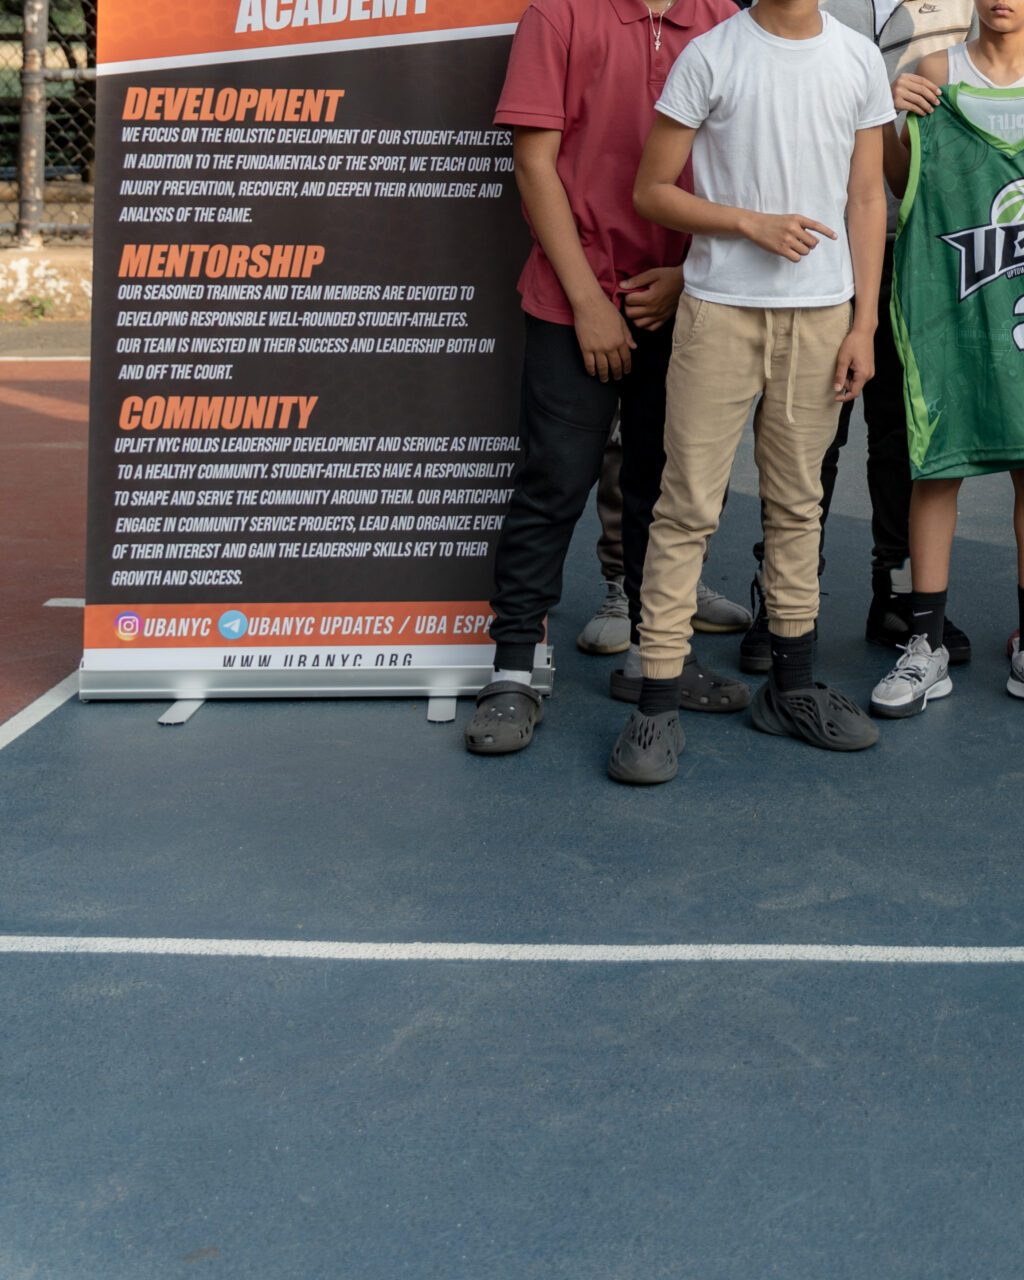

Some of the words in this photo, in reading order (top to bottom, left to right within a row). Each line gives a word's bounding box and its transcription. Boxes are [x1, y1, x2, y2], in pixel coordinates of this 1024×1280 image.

[121, 87, 345, 122] DEVELOPMENT
[121, 126, 142, 142] WE
[141, 126, 181, 143] FOCUS
[180, 127, 200, 143] ON
[201, 127, 224, 143] THE
[223, 127, 277, 144] HOLISTIC
[276, 128, 361, 144] DEVELOPMENT
[360, 129, 378, 145] OF
[377, 129, 402, 145] OUR
[402, 129, 512, 146] STUDENT-ATHLETES.
[119, 180, 162, 196] INJURY
[161, 180, 236, 198] PREVENTION,
[238, 180, 300, 199] RECOVERY,
[300, 181, 326, 197] AND
[326, 181, 372, 197] DEEPEN
[374, 182, 407, 197] THEIR
[407, 182, 478, 198] KNOWLEDGE
[478, 183, 503, 198] AND
[118, 206, 175, 223] ANALYSIS
[175, 206, 193, 222] OF
[194, 206, 217, 223] THE
[216, 207, 253, 223] GAME.
[118, 243, 325, 279] MENTORSHIP
[117, 284, 143, 300] OUR
[143, 284, 205, 300] SEASONED
[206, 284, 263, 300] TRAINERS
[262, 284, 289, 300] AND
[290, 284, 323, 300] TEAM
[323, 285, 382, 301] MEMBERS
[381, 285, 407, 300] ARE
[406, 285, 458, 301] DEVOTED
[460, 286, 475, 301] TO
[116, 310, 189, 327] DEVELOPING
[189, 310, 268, 327] RESPONSIBLE
[268, 311, 357, 327] WELL-ROUNDED
[357, 311, 468, 327] STUDENT-ATHLETES.
[116, 337, 142, 353] OUR
[143, 337, 177, 353] TEAM
[177, 337, 191, 353] IS
[190, 337, 247, 354] INVESTED
[247, 337, 262, 353] IN
[263, 337, 297, 353] THEIR
[297, 337, 350, 353] SUCCESS
[349, 337, 375, 353] AND
[375, 338, 446, 353] LEADERSHIP
[446, 338, 478, 353] BOTH
[478, 338, 495, 353] ON
[118, 364, 145, 380] AND
[145, 364, 170, 380] OFF
[170, 364, 194, 380] THE
[193, 364, 234, 380] COURT.
[119, 395, 319, 430] COMMUNITY
[114, 437, 157, 453] UPLIFT
[155, 436, 181, 453] NYC
[181, 437, 221, 453] HOLDS
[220, 436, 292, 453] LEADERSHIP
[292, 436, 377, 452] DEVELOPMENT
[375, 436, 402, 452] AND
[401, 436, 450, 452] SERVICE
[449, 436, 467, 452] AS
[467, 436, 519, 451] INTEGRAL
[118, 464, 134, 480] TO
[133, 464, 143, 480] A
[144, 463, 197, 480] HEALTHY
[197, 463, 269, 480] COMMUNITY.
[270, 463, 382, 479] STUDENT-ATHLETES
[382, 462, 414, 478] HAVE
[413, 463, 422, 478] A
[423, 462, 512, 478] RESPONSIBILITY
[111, 543, 129, 560] OF
[130, 543, 165, 559] THEIR
[164, 543, 222, 559] INTEREST
[220, 543, 248, 559] AND
[247, 542, 277, 559] GAIN
[278, 542, 302, 558] THE
[301, 542, 372, 558] LEADERSHIP
[372, 541, 413, 557] SKILLS
[413, 541, 438, 557] KEY
[439, 541, 454, 557] TO
[456, 541, 488, 557] THEIR
[111, 570, 163, 586] GROWTH
[162, 570, 189, 586] AND
[188, 569, 243, 586] SUCCESS.
[143, 618, 212, 637] UBANYC
[247, 616, 315, 636] UBANYC
[319, 616, 394, 635] UPDATES
[414, 615, 448, 635] UBA
[453, 615, 494, 634] ESPA
